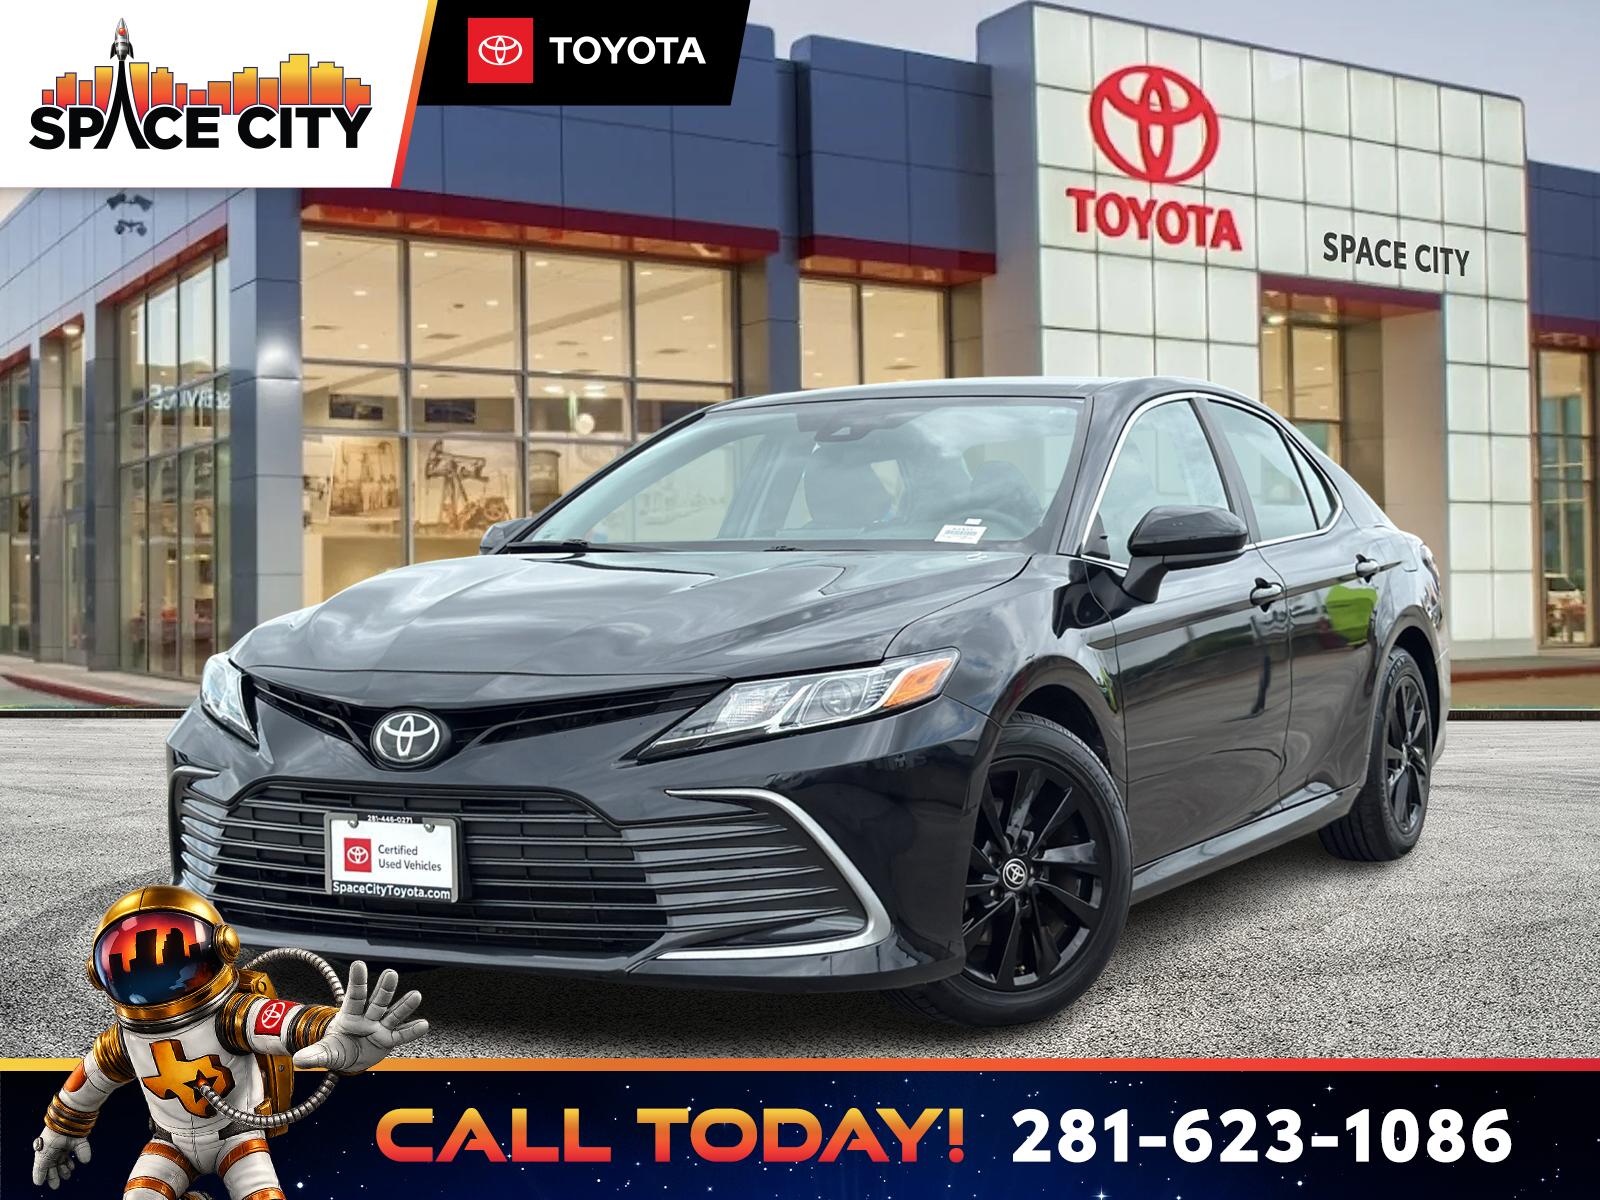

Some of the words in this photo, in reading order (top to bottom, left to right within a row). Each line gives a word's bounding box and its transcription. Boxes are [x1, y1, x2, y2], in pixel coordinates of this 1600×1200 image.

[1066, 187, 1243, 251] TOYOTA
[1323, 232, 1407, 270] SPACE
[1415, 243, 1471, 277] CITY
[378, 844, 418, 856] Certified
[378, 859, 402, 869] Used
[404, 860, 442, 872] Vehicles
[333, 882, 451, 900] SpaceCityToyota.com
